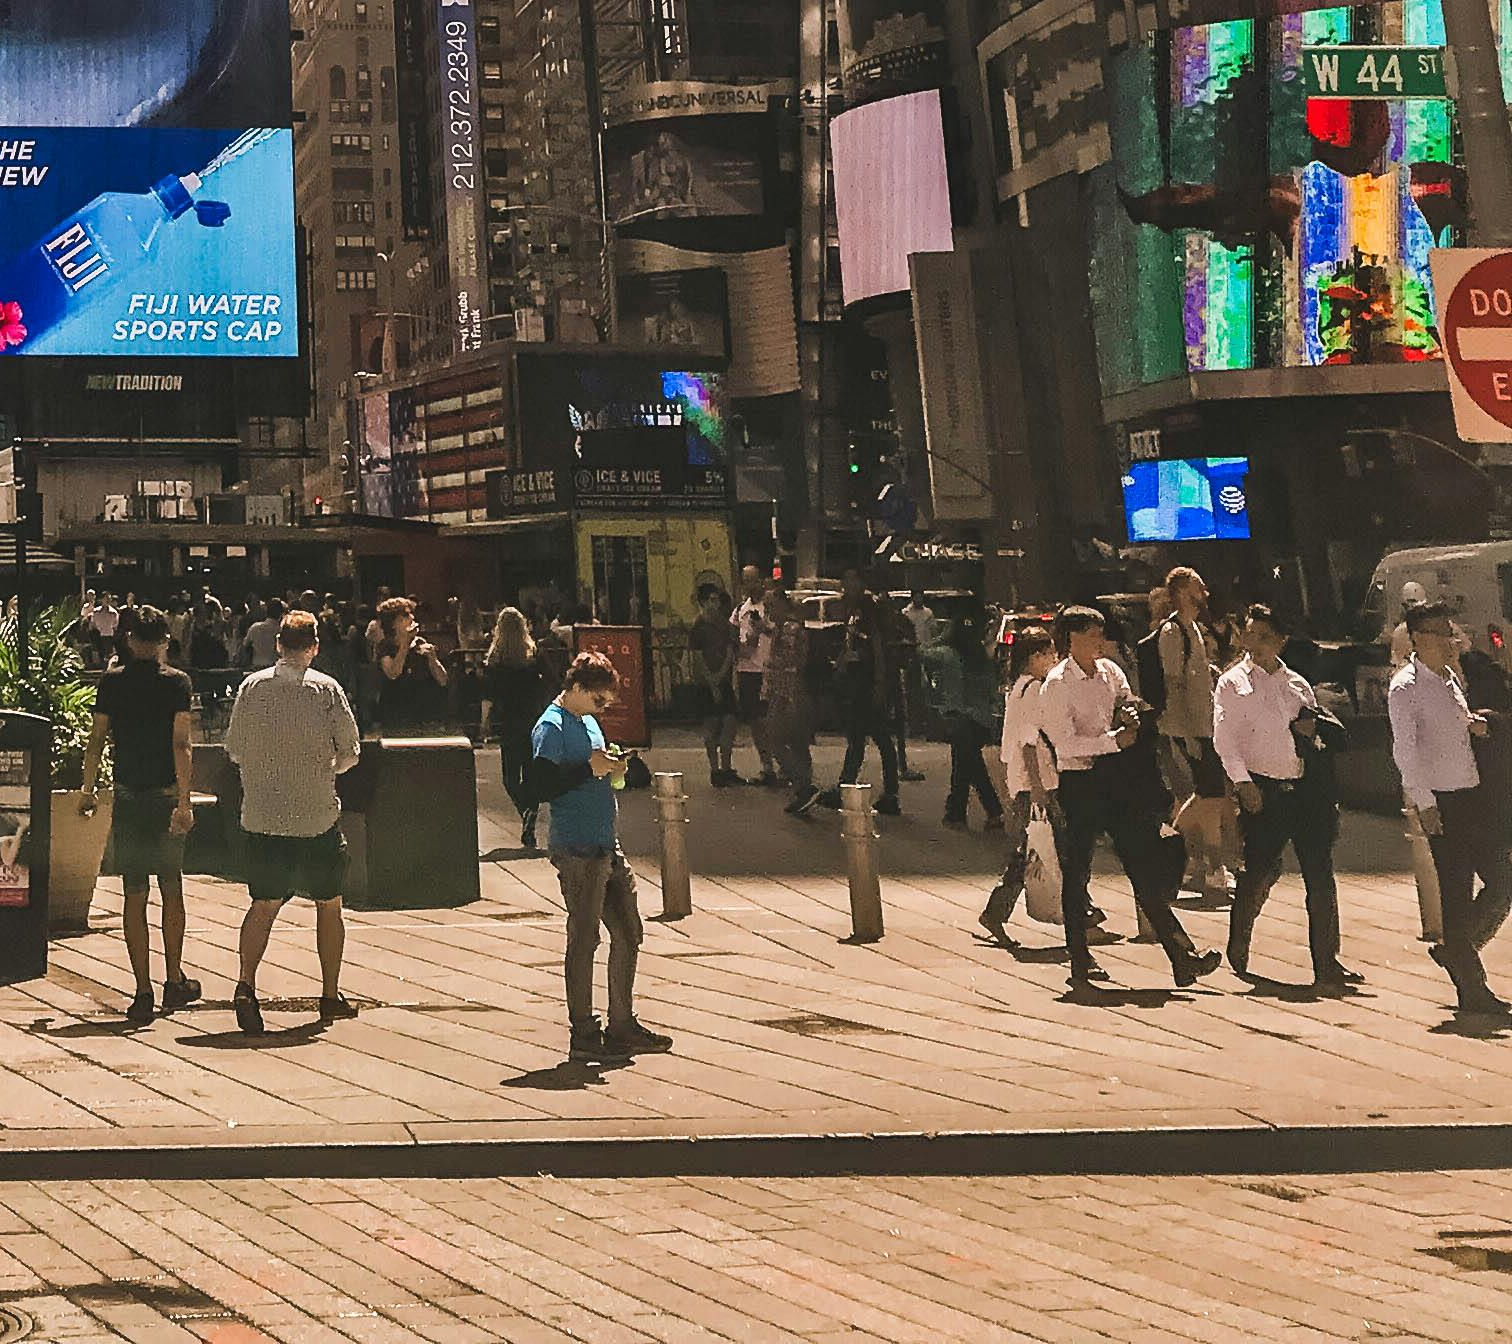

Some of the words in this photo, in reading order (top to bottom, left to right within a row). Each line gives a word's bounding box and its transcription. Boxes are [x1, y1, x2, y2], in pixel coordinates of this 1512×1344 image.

[1312, 54, 1340, 93] W
[1356, 54, 1404, 93] 44
[1418, 53, 1438, 75] ST
[445, 20, 475, 190] 212.372.2349
[43, 222, 110, 294] FIJI
[129, 294, 178, 315] FIJI
[188, 295, 281, 315] WATER
[112, 320, 219, 341] SPORTS
[227, 321, 282, 341] CAP
[596, 469, 617, 483] ICE
[620, 470, 629, 483] &
[633, 470, 661, 483] VICE
